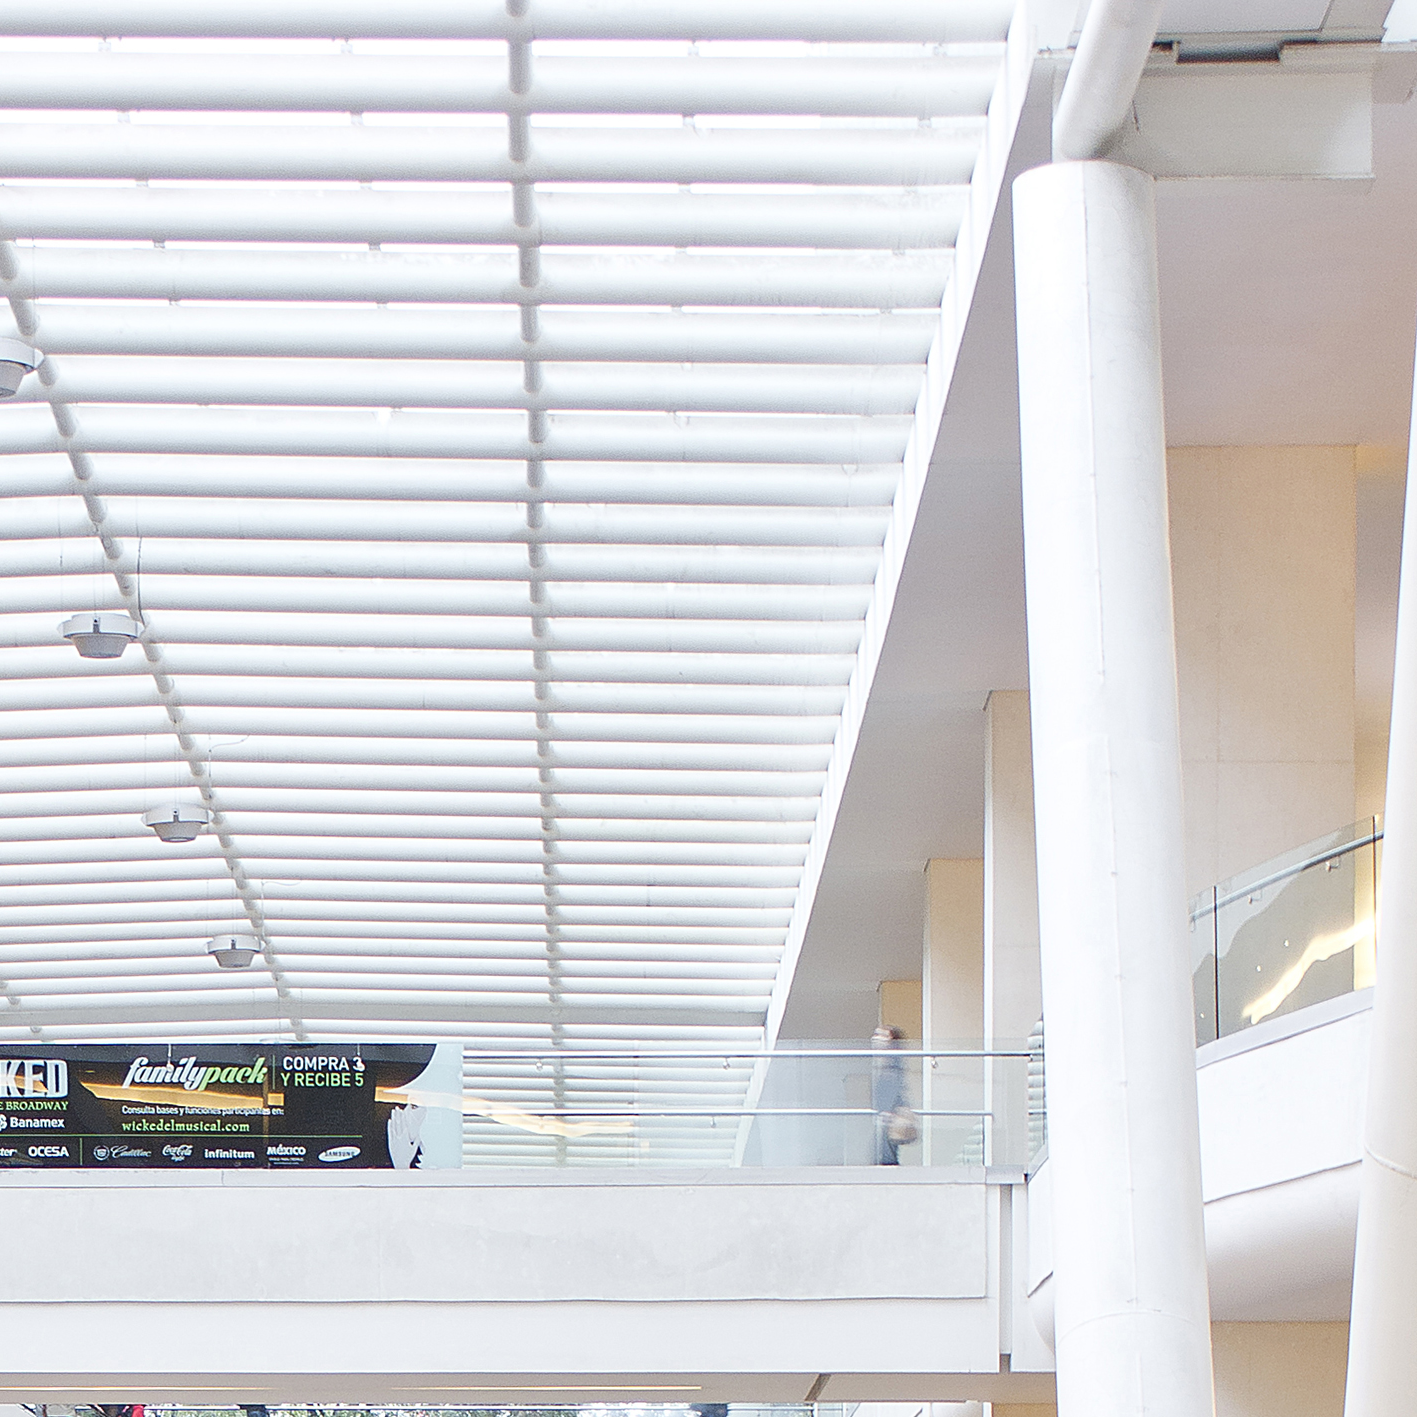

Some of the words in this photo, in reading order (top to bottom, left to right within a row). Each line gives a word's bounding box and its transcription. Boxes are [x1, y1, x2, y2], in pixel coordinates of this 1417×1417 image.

[283, 1057, 347, 1071] COMPRA
[281, 1073, 291, 1086] Y
[294, 1073, 350, 1086] RECIBE
[356, 1073, 364, 1086] 5
[6, 1102, 68, 1111] BROADWAY
[122, 1105, 155, 1115] Consulta
[156, 1105, 178, 1115] bases
[10, 1117, 65, 1129] Banamex
[122, 1119, 250, 1132] wickedelmusical.com
[28, 1146, 69, 1157] OCESA
[204, 1149, 255, 1159] infinitum
